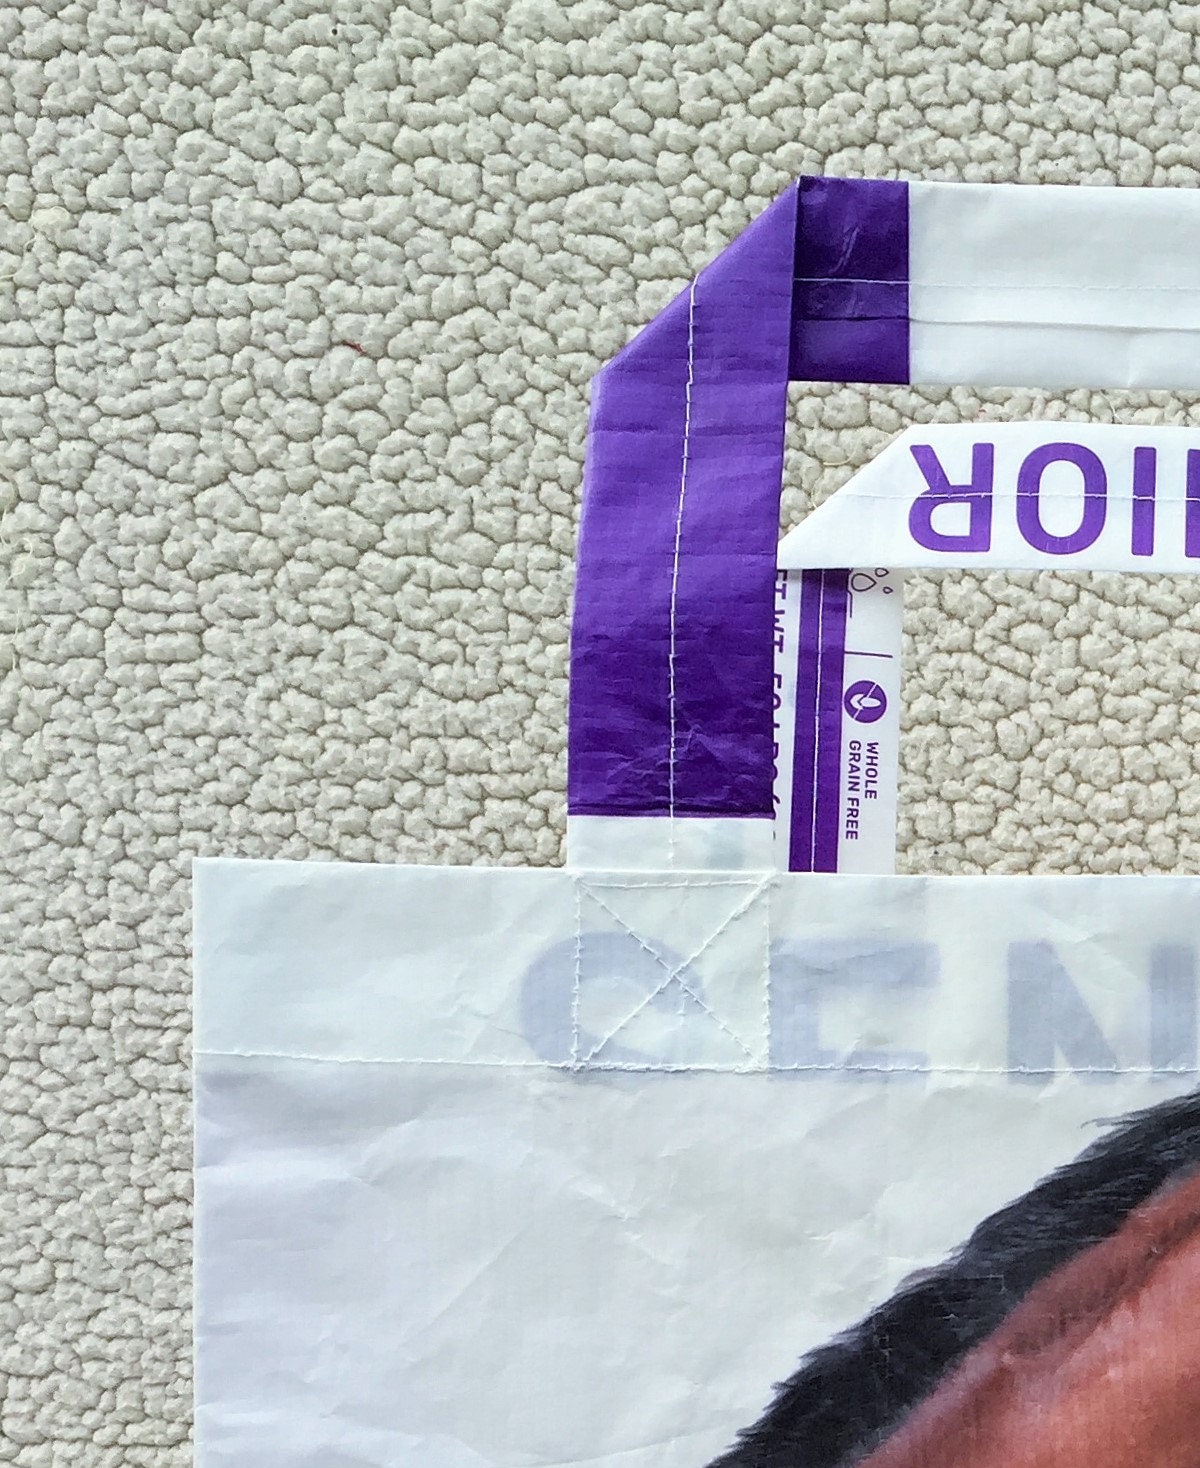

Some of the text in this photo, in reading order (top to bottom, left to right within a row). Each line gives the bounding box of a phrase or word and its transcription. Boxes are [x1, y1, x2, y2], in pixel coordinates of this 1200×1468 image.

[845, 739, 863, 841] GRAIN FREE
[864, 741, 879, 800] WHOLE
